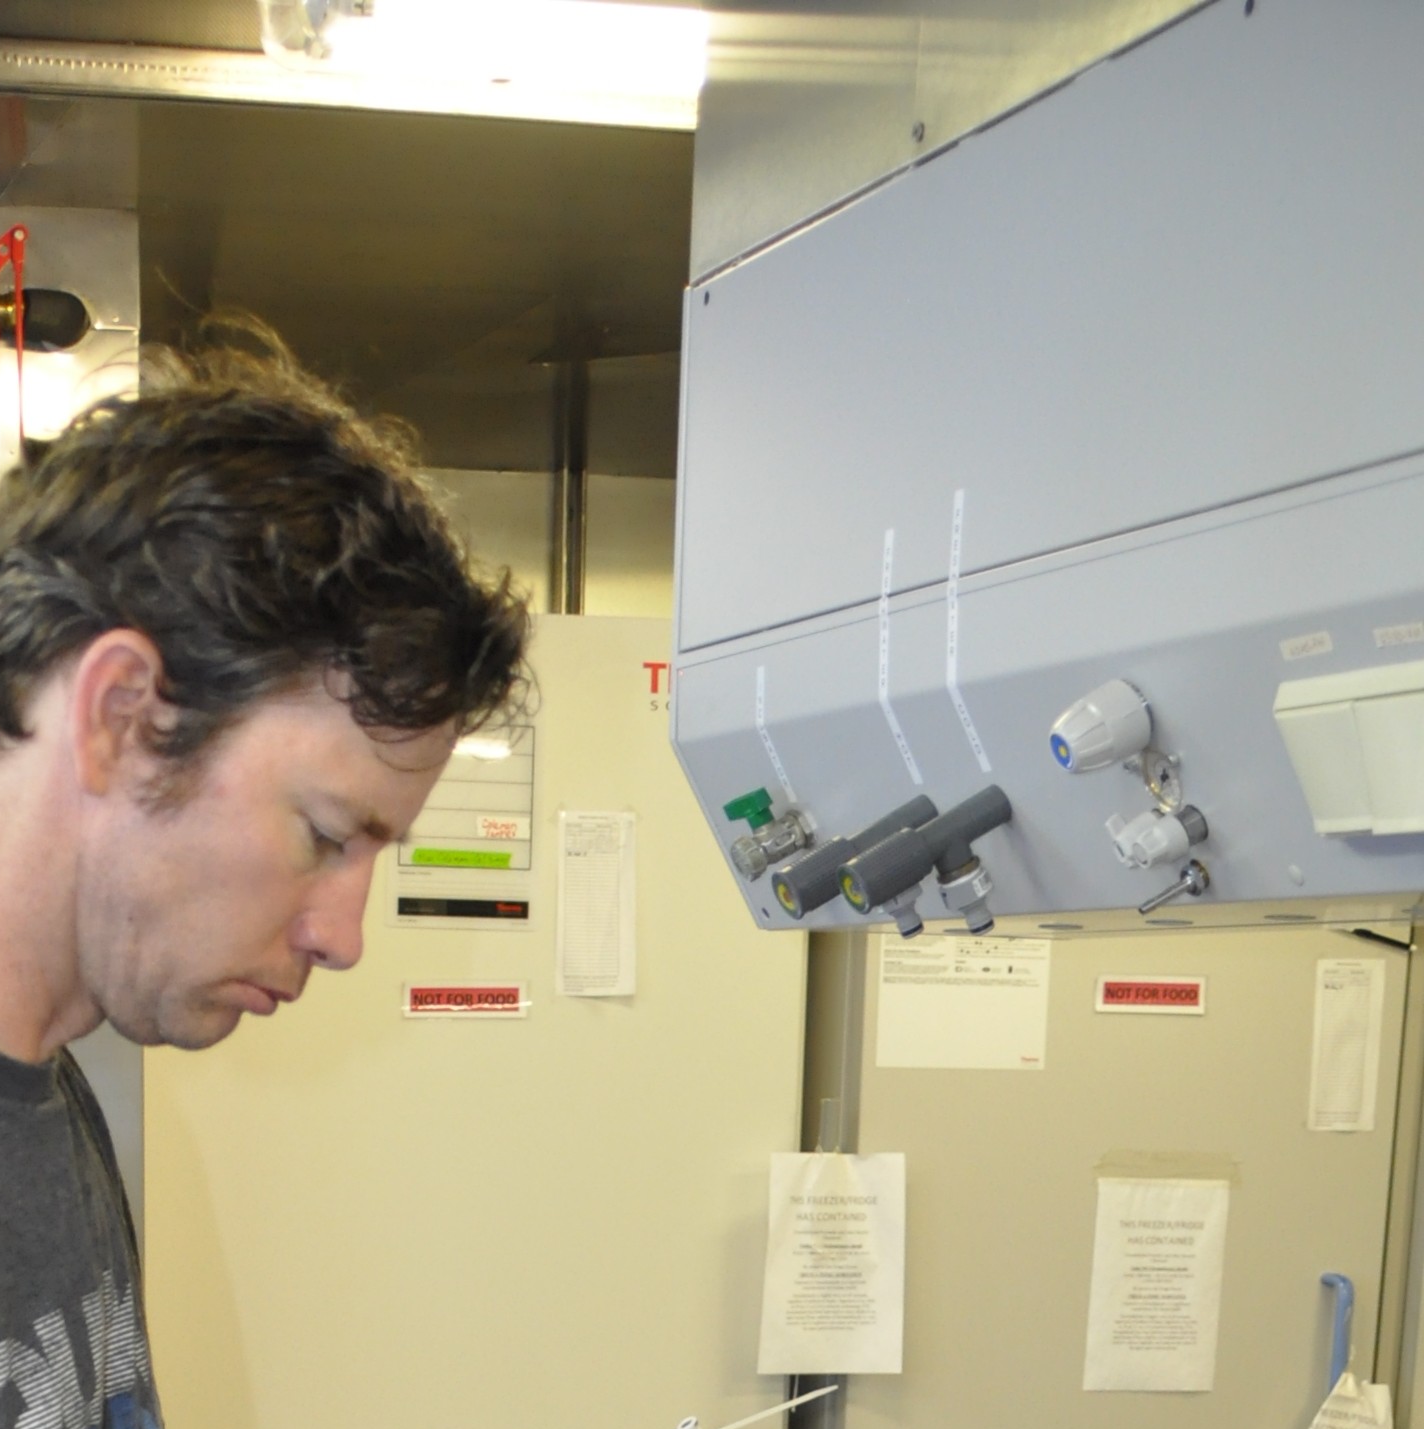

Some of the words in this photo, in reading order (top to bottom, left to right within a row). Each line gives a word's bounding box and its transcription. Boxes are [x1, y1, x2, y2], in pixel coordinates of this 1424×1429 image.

[413, 993, 442, 1006] NOT
[446, 993, 473, 1006] FOR
[478, 993, 516, 1005] FOOD
[1104, 987, 1132, 999] NOT
[1135, 987, 1159, 999] FOR
[1162, 988, 1198, 1000] FOOD
